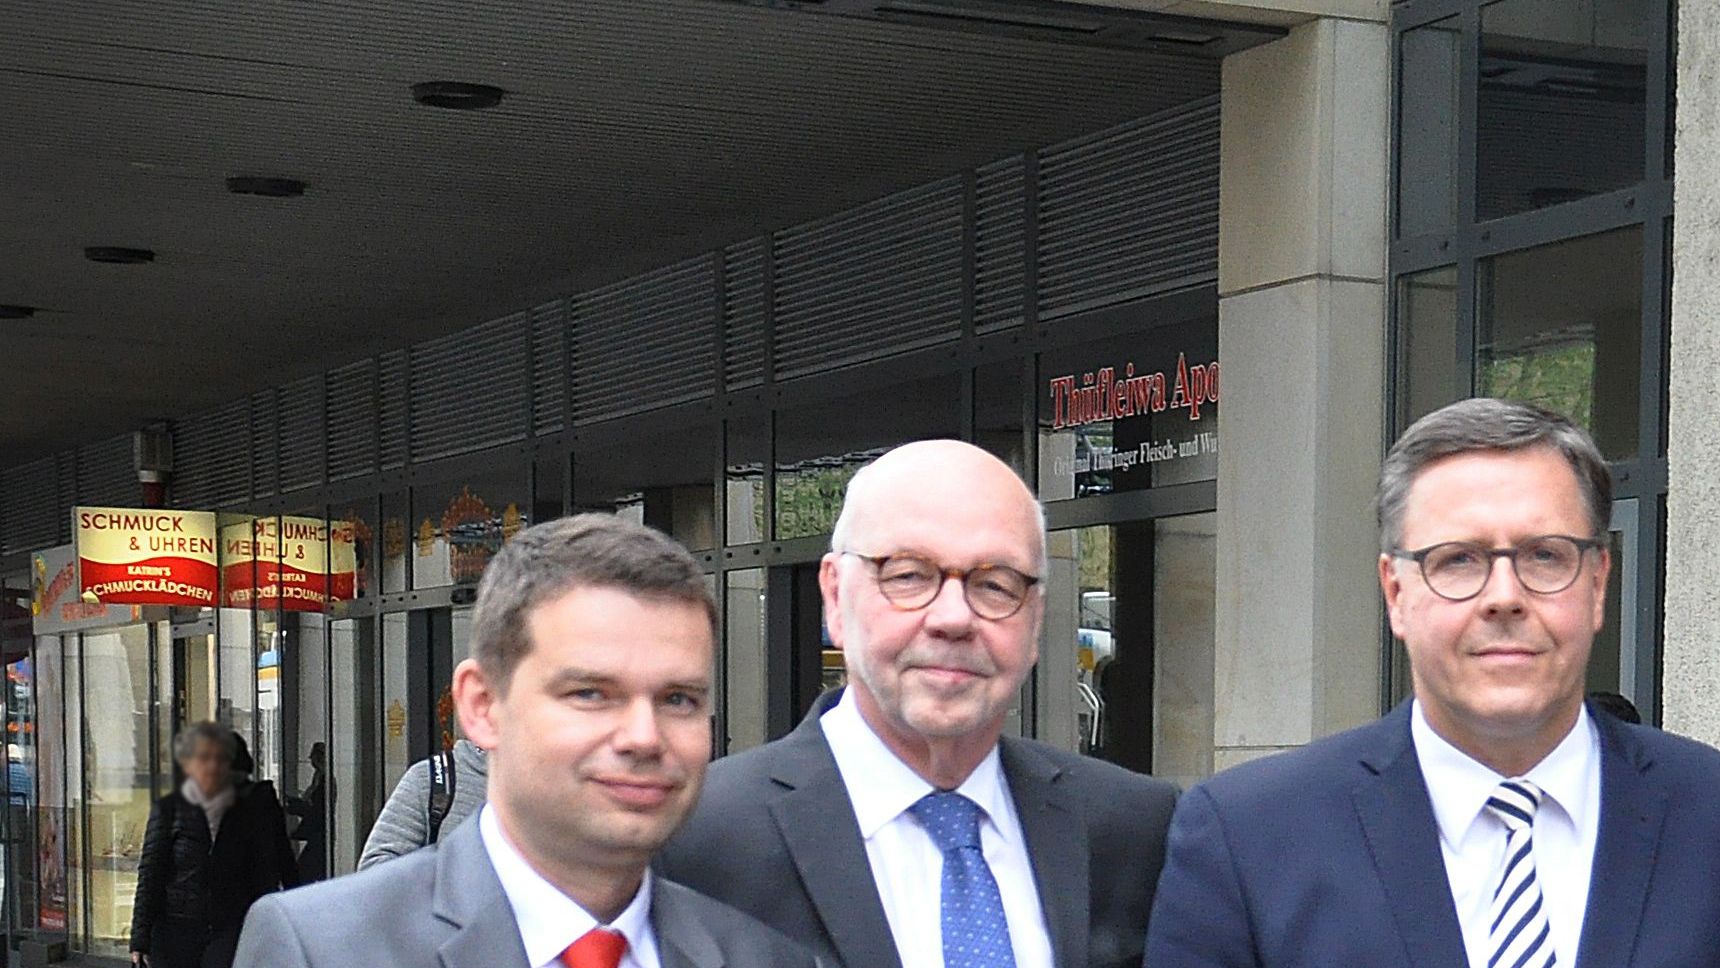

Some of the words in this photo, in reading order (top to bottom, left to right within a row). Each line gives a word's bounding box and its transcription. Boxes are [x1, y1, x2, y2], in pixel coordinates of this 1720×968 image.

[1050, 362, 1167, 430] Thüfleiwa
[81, 512, 184, 534] SCHMUCK
[129, 535, 142, 552] &
[149, 535, 214, 554] UHREN
